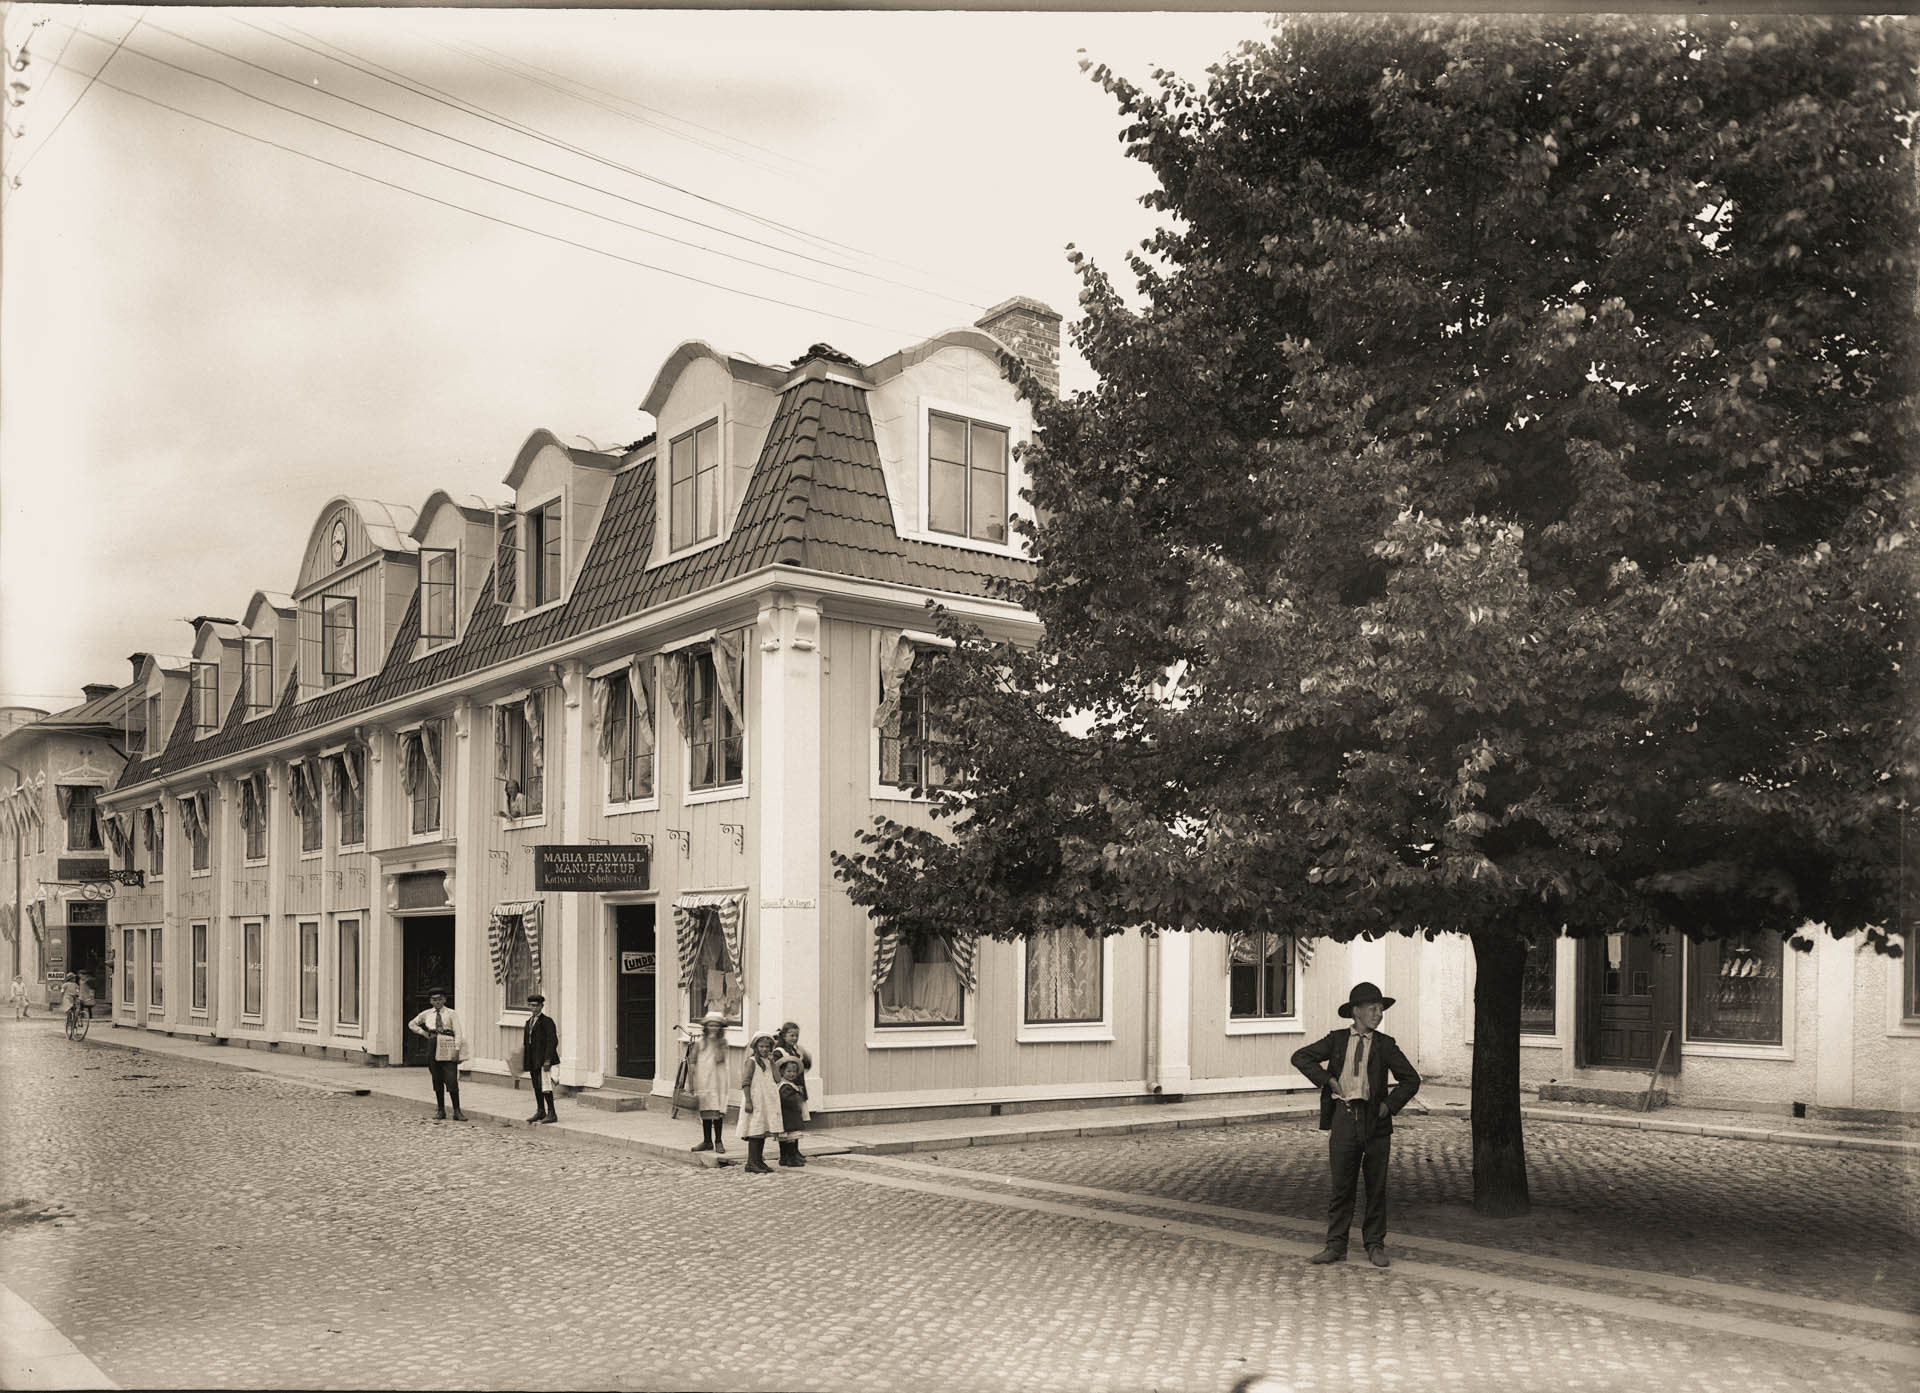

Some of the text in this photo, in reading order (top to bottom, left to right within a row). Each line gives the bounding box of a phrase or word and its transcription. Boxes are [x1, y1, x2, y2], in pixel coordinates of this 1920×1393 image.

[543, 853, 645, 863] MARIA RENVALL
[555, 863, 636, 873] MANUFAKTUR
